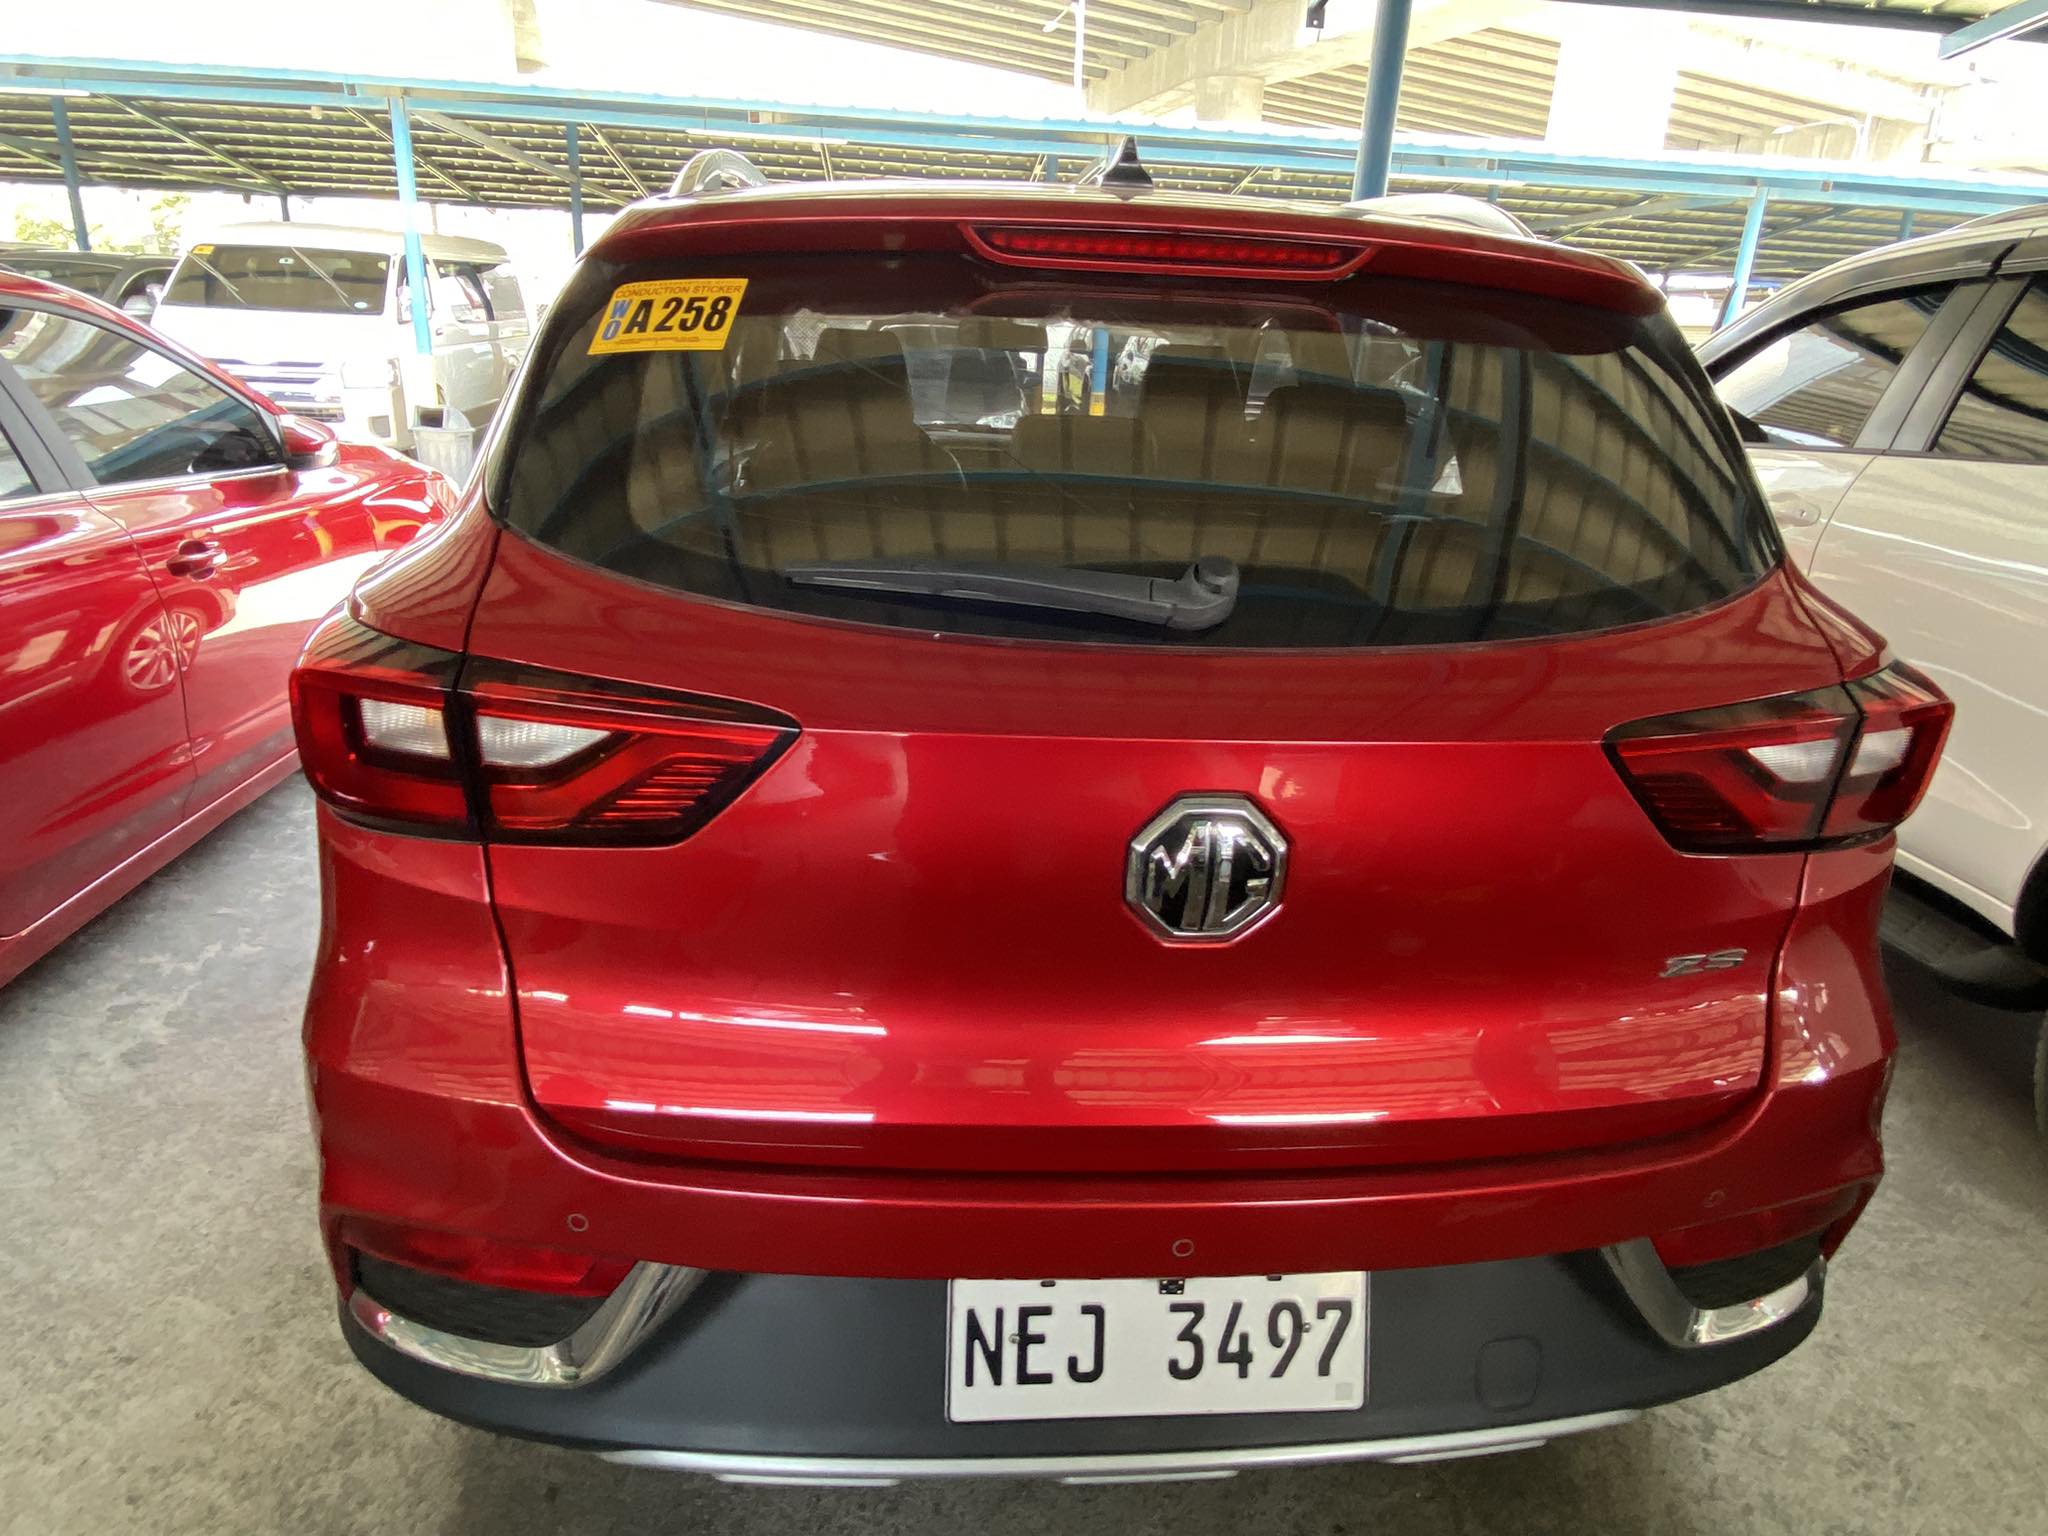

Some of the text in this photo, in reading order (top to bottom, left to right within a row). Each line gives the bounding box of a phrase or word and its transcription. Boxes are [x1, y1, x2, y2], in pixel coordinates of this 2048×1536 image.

[615, 286, 689, 299] CONDUCTION
[693, 284, 742, 294] STICKER
[1146, 820, 1271, 931] MG
[1659, 948, 1747, 977] ZS
[965, 1299, 1353, 1387] NEJ 3497
